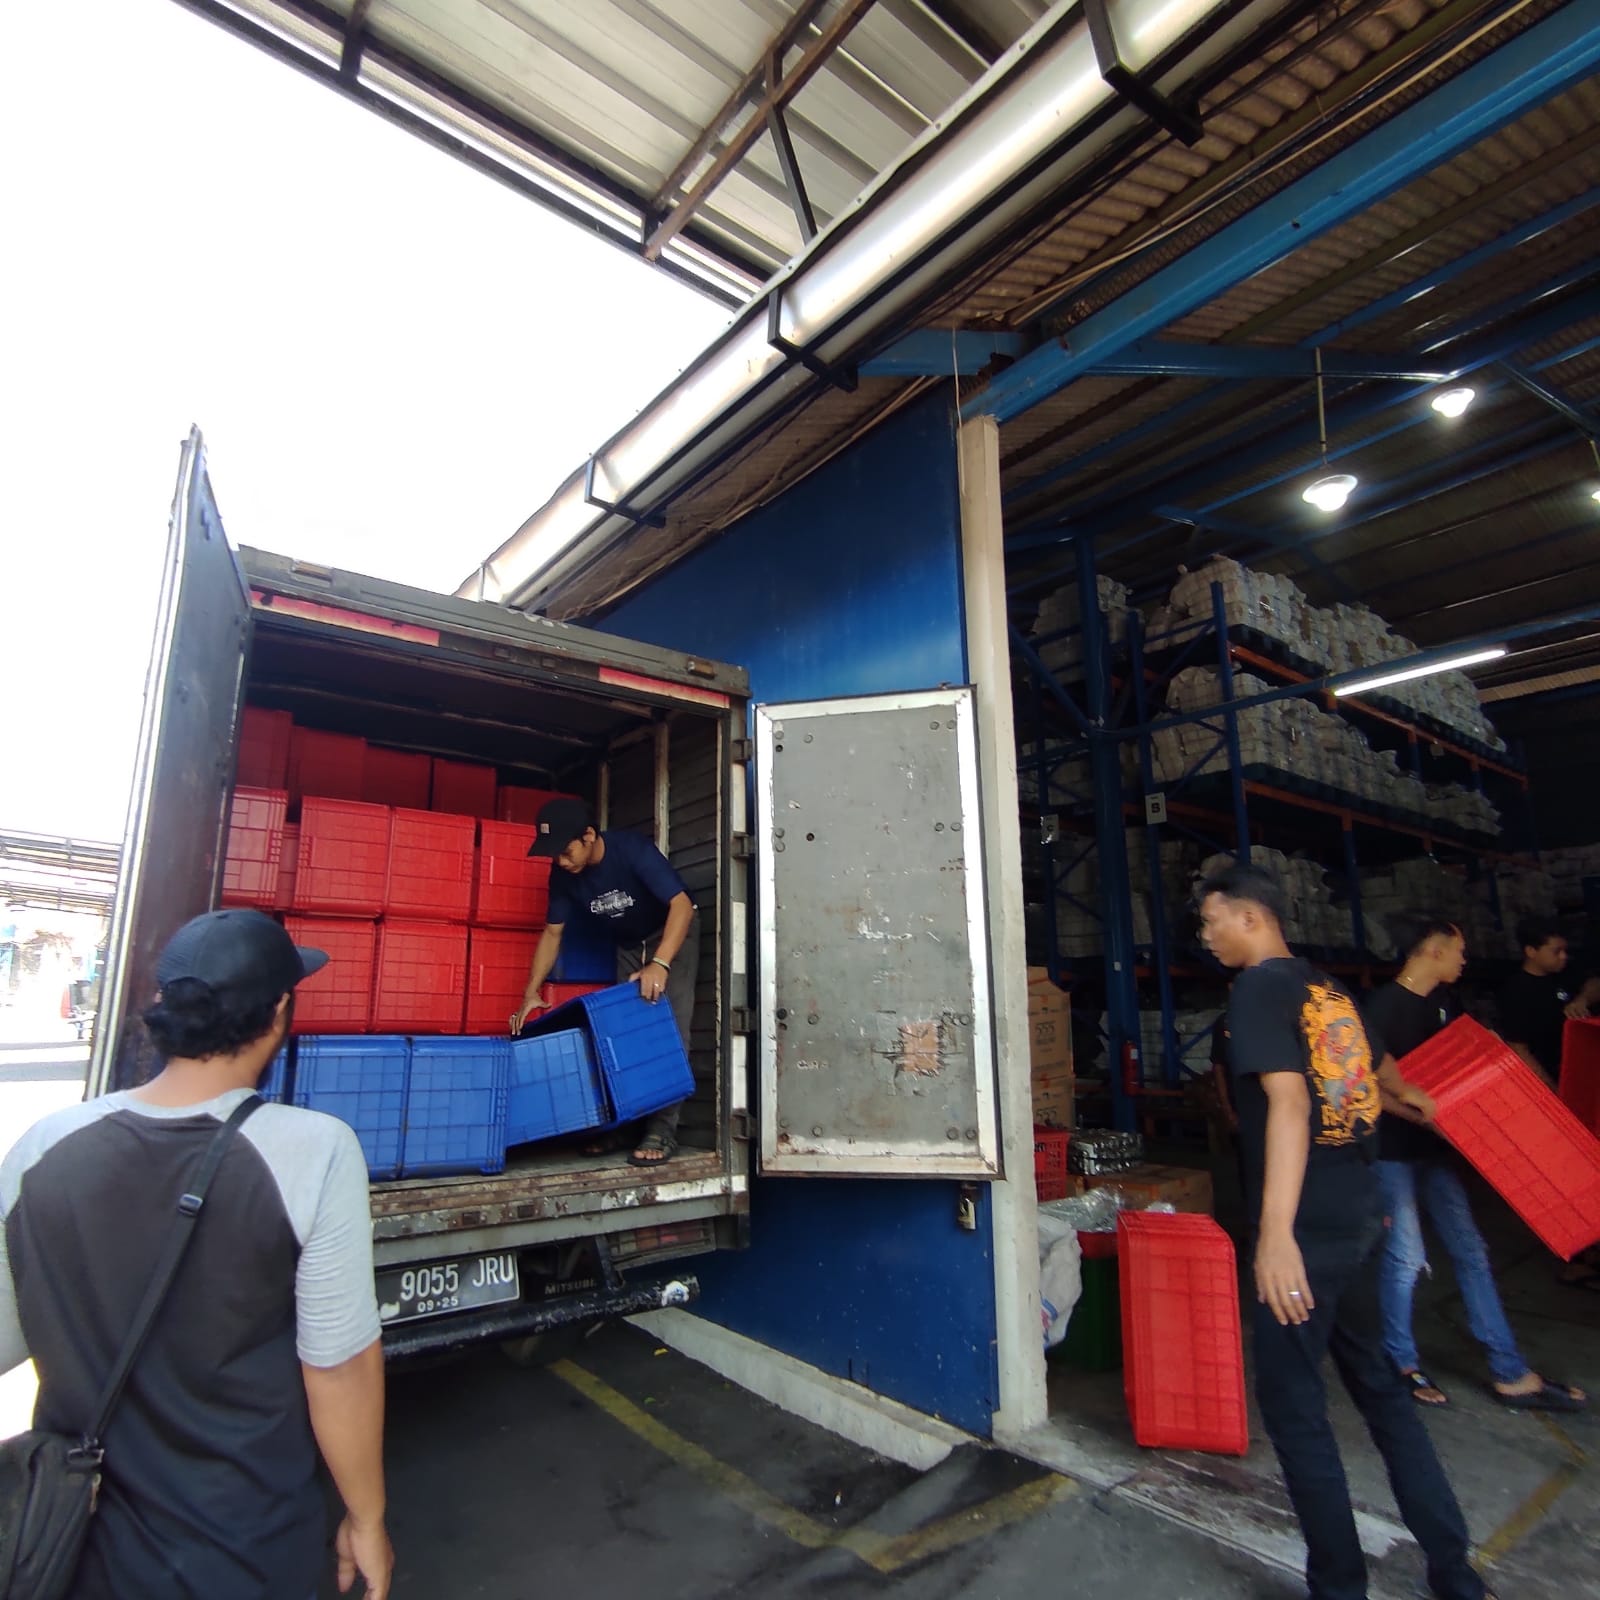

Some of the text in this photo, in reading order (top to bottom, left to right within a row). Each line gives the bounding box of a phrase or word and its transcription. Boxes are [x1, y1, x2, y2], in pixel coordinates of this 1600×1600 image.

[1151, 803, 1160, 813] B
[400, 1254, 515, 1301] 9055 JRU
